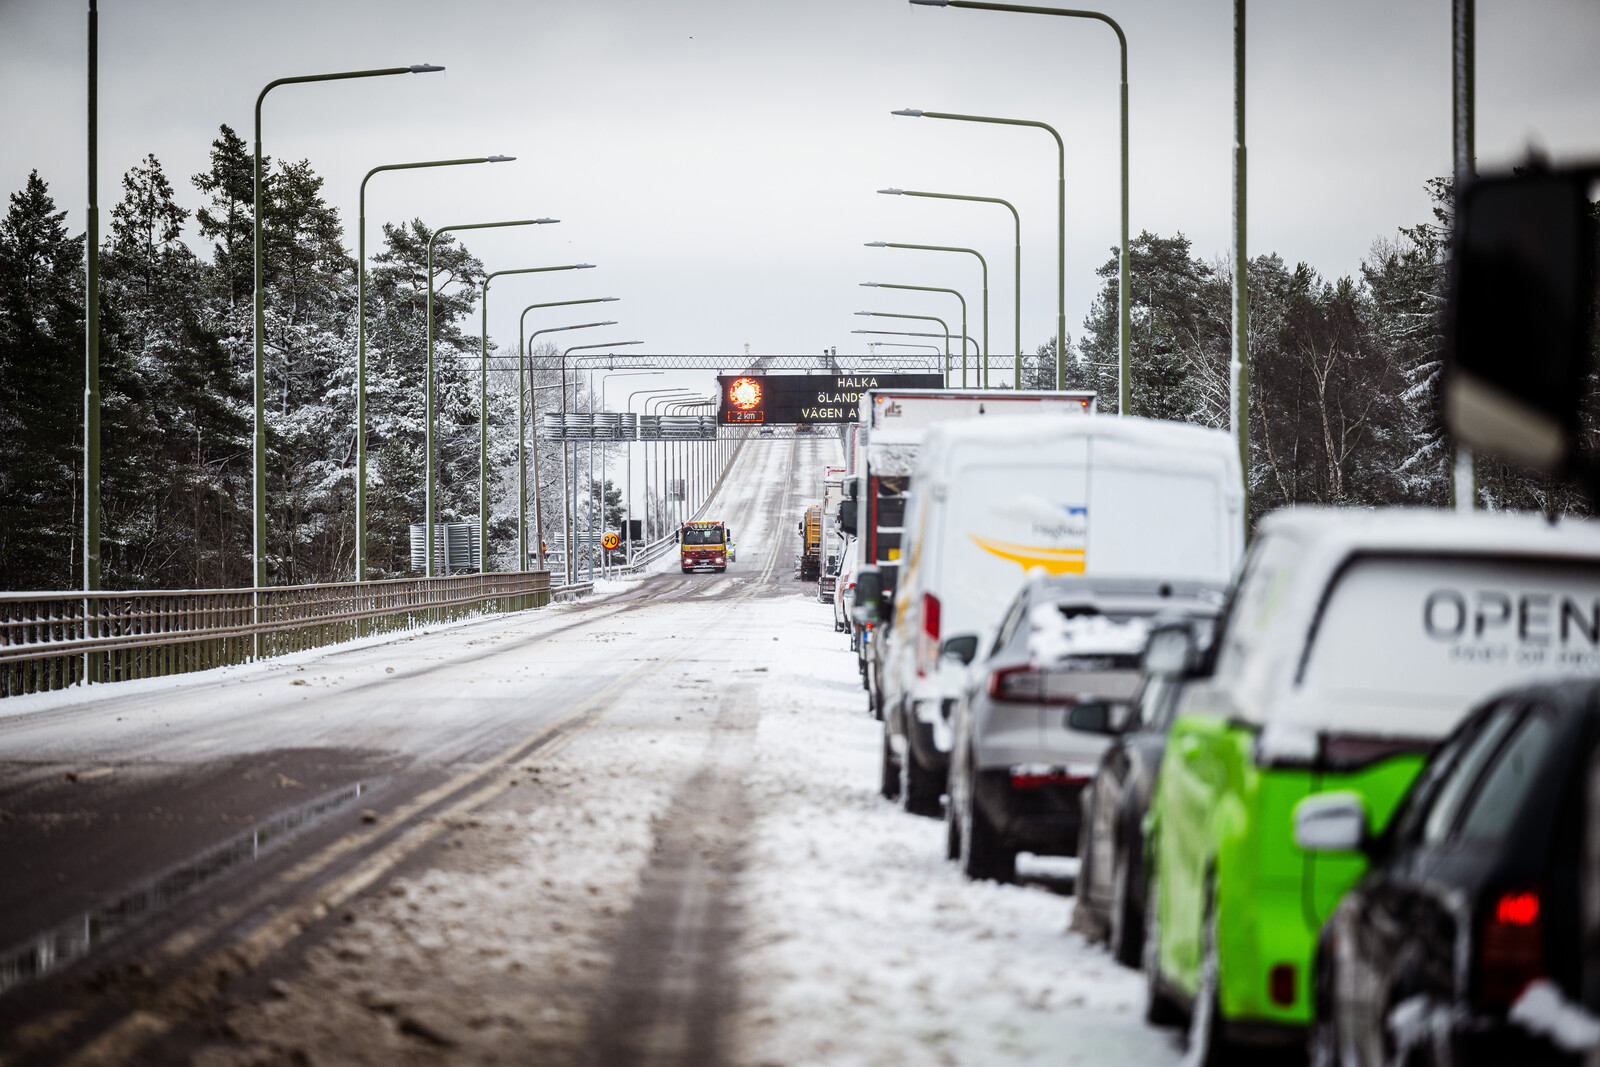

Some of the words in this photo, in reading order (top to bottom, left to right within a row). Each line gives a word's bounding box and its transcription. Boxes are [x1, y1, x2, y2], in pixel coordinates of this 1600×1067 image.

[837, 377, 878, 388] HALKA
[737, 412, 742, 420] 2
[743, 412, 756, 420] km
[801, 407, 843, 418] VÄGEN
[604, 536, 617, 546] 90
[1423, 587, 1600, 645] OPEN
